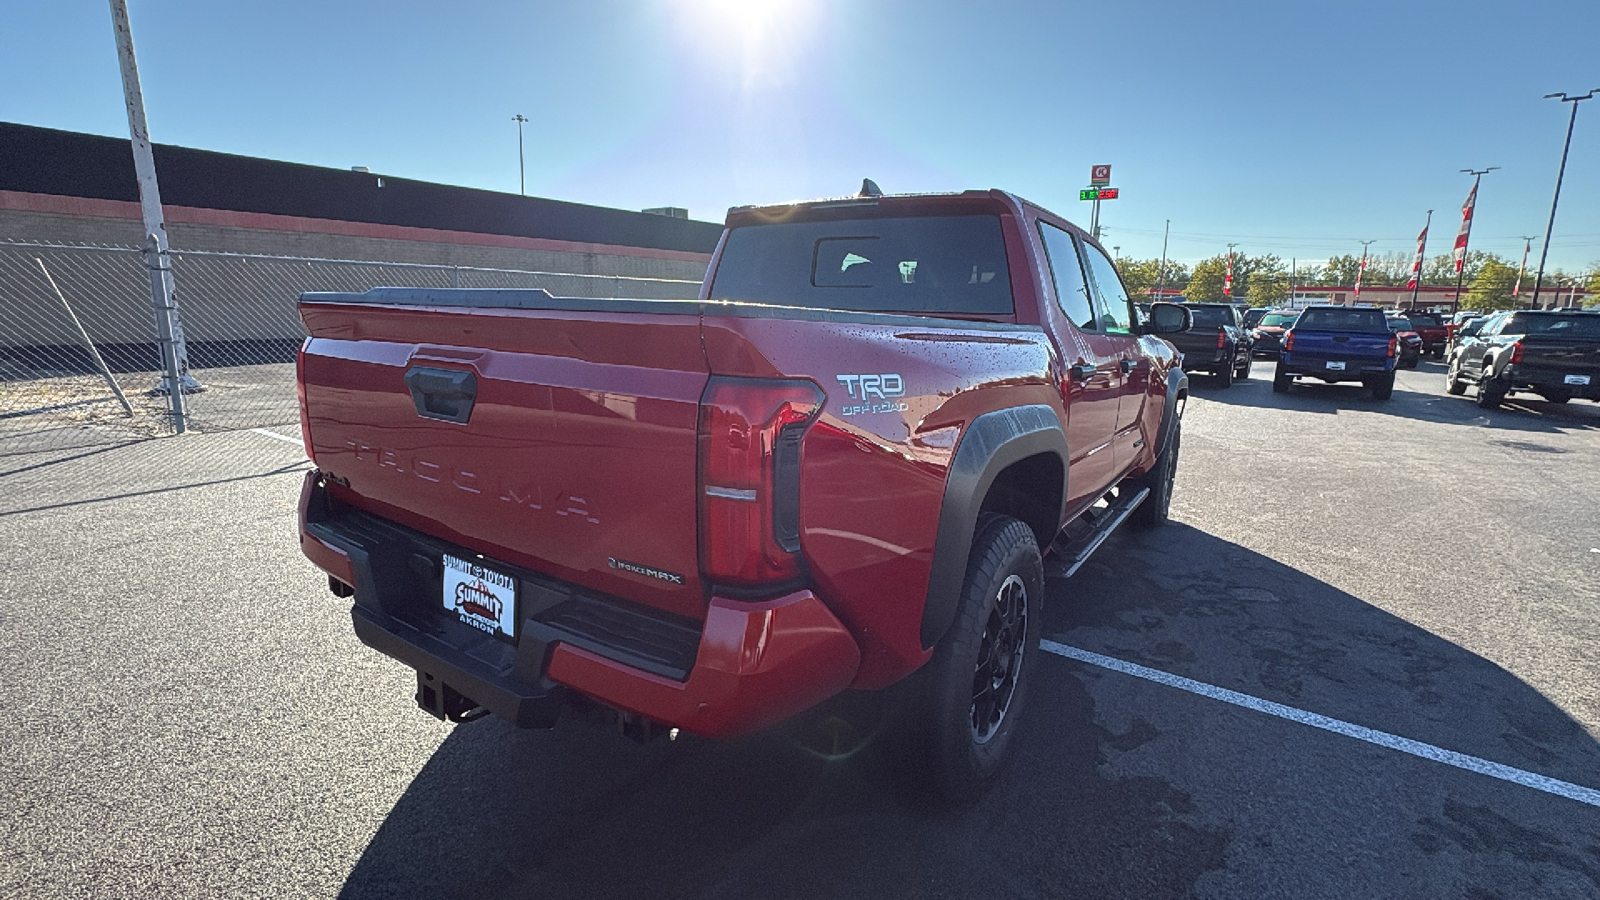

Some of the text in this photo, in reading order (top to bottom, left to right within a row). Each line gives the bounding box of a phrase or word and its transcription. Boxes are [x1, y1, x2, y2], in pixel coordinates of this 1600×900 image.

[836, 373, 904, 401] TRD
[442, 553, 514, 591] SUMMIT TOYOTA
[646, 568, 682, 584] MAX
[456, 584, 501, 620] SUMMIT
[459, 614, 494, 635] AKRON
